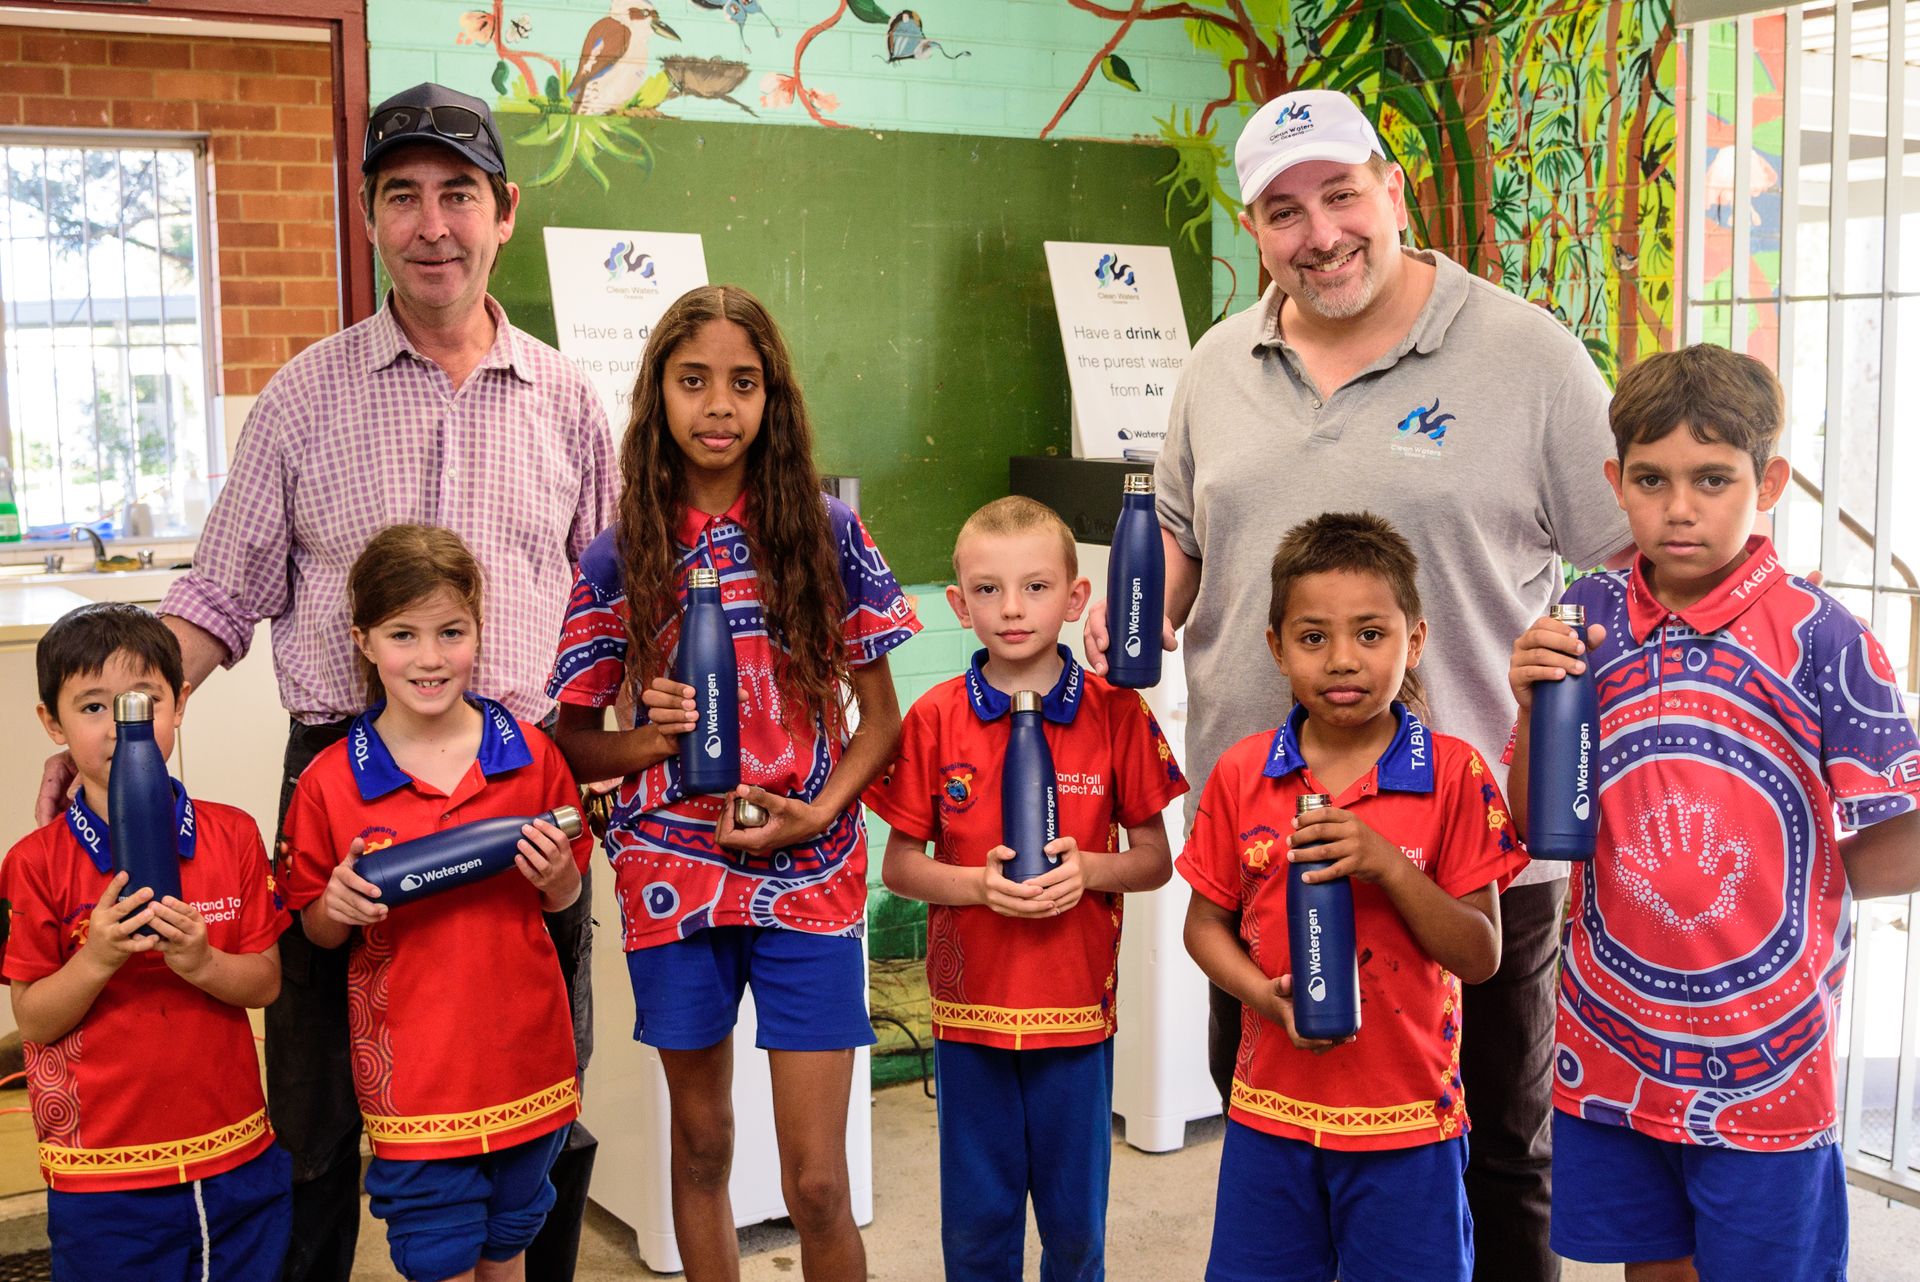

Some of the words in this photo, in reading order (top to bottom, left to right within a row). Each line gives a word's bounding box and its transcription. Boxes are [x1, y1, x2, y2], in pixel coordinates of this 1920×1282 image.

[1289, 124, 1314, 132] Waters
[607, 286, 630, 294] Clean
[631, 287, 659, 295] Waters
[574, 324, 618, 339] Have
[623, 327, 633, 339] a
[1074, 326, 1109, 339] Have
[1114, 329, 1122, 339] a
[1126, 327, 1162, 340] drink
[1165, 327, 1177, 340] of
[576, 357, 603, 372] the
[1078, 355, 1100, 368] the
[1104, 356, 1146, 370] purest
[1148, 357, 1184, 368] water
[1110, 383, 1141, 397] from
[1145, 383, 1164, 397] Air
[1128, 577, 1143, 635] Watergen
[706, 673, 720, 735] Watergen
[489, 704, 515, 745] TABU
[1577, 722, 1591, 792] Watergen
[1056, 772, 1079, 783] and
[1081, 773, 1101, 785] Tall
[1058, 784, 1088, 795] spect
[1090, 784, 1104, 796] All
[1046, 786, 1056, 841] Watergen
[1400, 845, 1423, 859] Tall
[422, 857, 483, 882] Watergen
[190, 897, 224, 912] Stand
[227, 896, 241, 909] Ta
[204, 908, 235, 925] spect
[1309, 908, 1322, 976] Watergen
